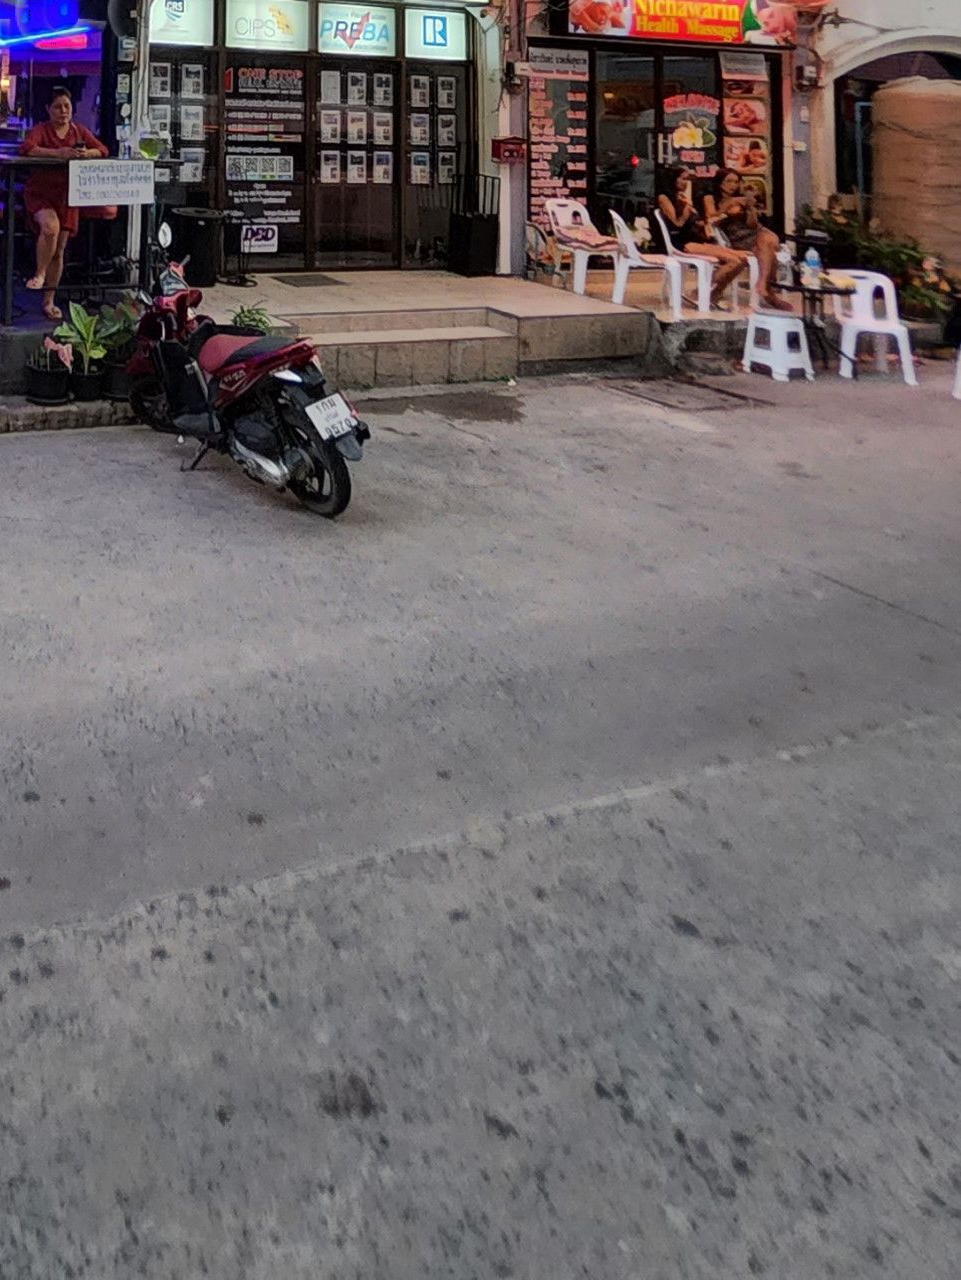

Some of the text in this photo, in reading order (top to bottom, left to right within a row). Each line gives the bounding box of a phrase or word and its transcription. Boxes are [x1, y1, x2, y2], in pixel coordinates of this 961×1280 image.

[166, 0, 184, 13] CRS
[234, 16, 276, 38] CIPS
[319, 19, 390, 43] PREBA
[635, 15, 739, 43] Health Massage
